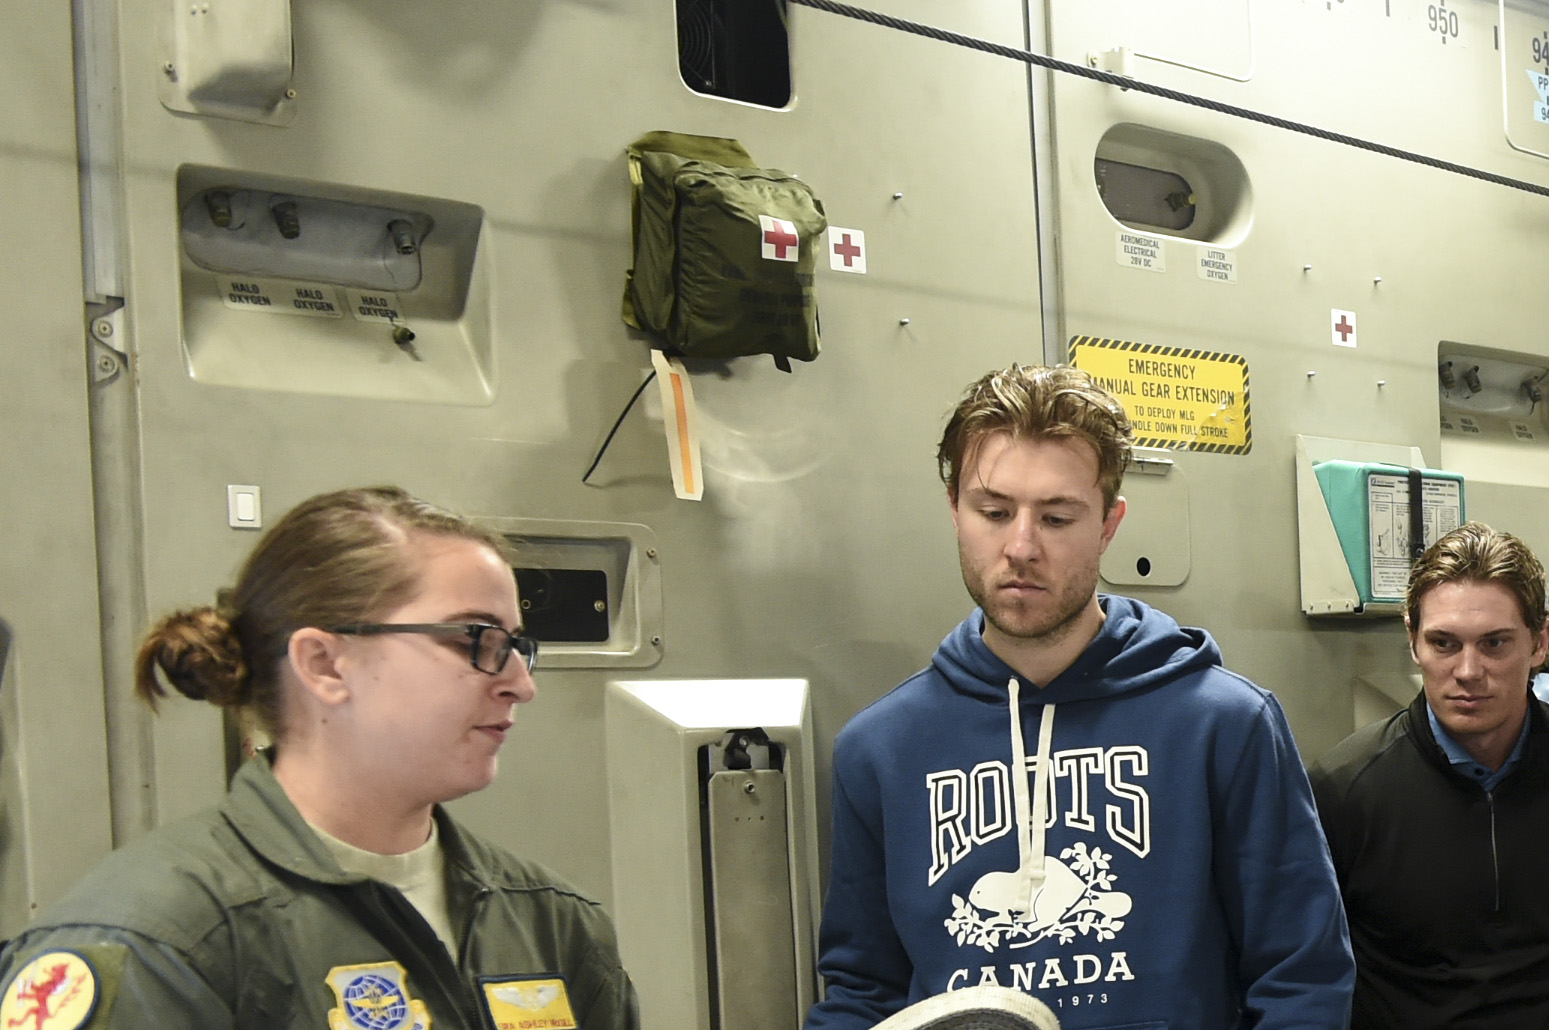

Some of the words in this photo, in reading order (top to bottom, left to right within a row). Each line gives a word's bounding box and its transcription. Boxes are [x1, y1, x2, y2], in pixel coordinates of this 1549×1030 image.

[1428, 6, 1459, 38] 950
[1538, 76, 1549, 91] PP
[1121, 234, 1160, 249] AEROMEDICAL
[1124, 245, 1157, 259] ELECTRICAL
[1207, 250, 1225, 261] LITTER
[1143, 258, 1152, 268] DC
[1201, 259, 1233, 271] EMERGENCY
[1207, 269, 1229, 280] OXYGEN
[231, 282, 260, 294] HALO
[296, 288, 323, 300] HALO
[228, 293, 271, 306] OXYGEN
[294, 299, 335, 312] OXYGEN
[361, 296, 388, 307] HALO
[358, 306, 398, 319] OXYGEN
[1128, 358, 1195, 380] EMERGENCY
[1142, 382, 1170, 399] GEAR
[1175, 385, 1235, 406] EXTENSION
[1135, 405, 1145, 416] TO
[1147, 407, 1176, 419] DEPLOY
[1179, 409, 1195, 421] MLG
[1130, 420, 1151, 432] NDLE
[1155, 421, 1178, 433] DOWN
[1181, 423, 1198, 436] FULL
[1201, 425, 1229, 438] STROKE
[926, 745, 1151, 887] ROOTS
[947, 951, 1135, 992] CANADA
[1057, 993, 1108, 1008] 1973
